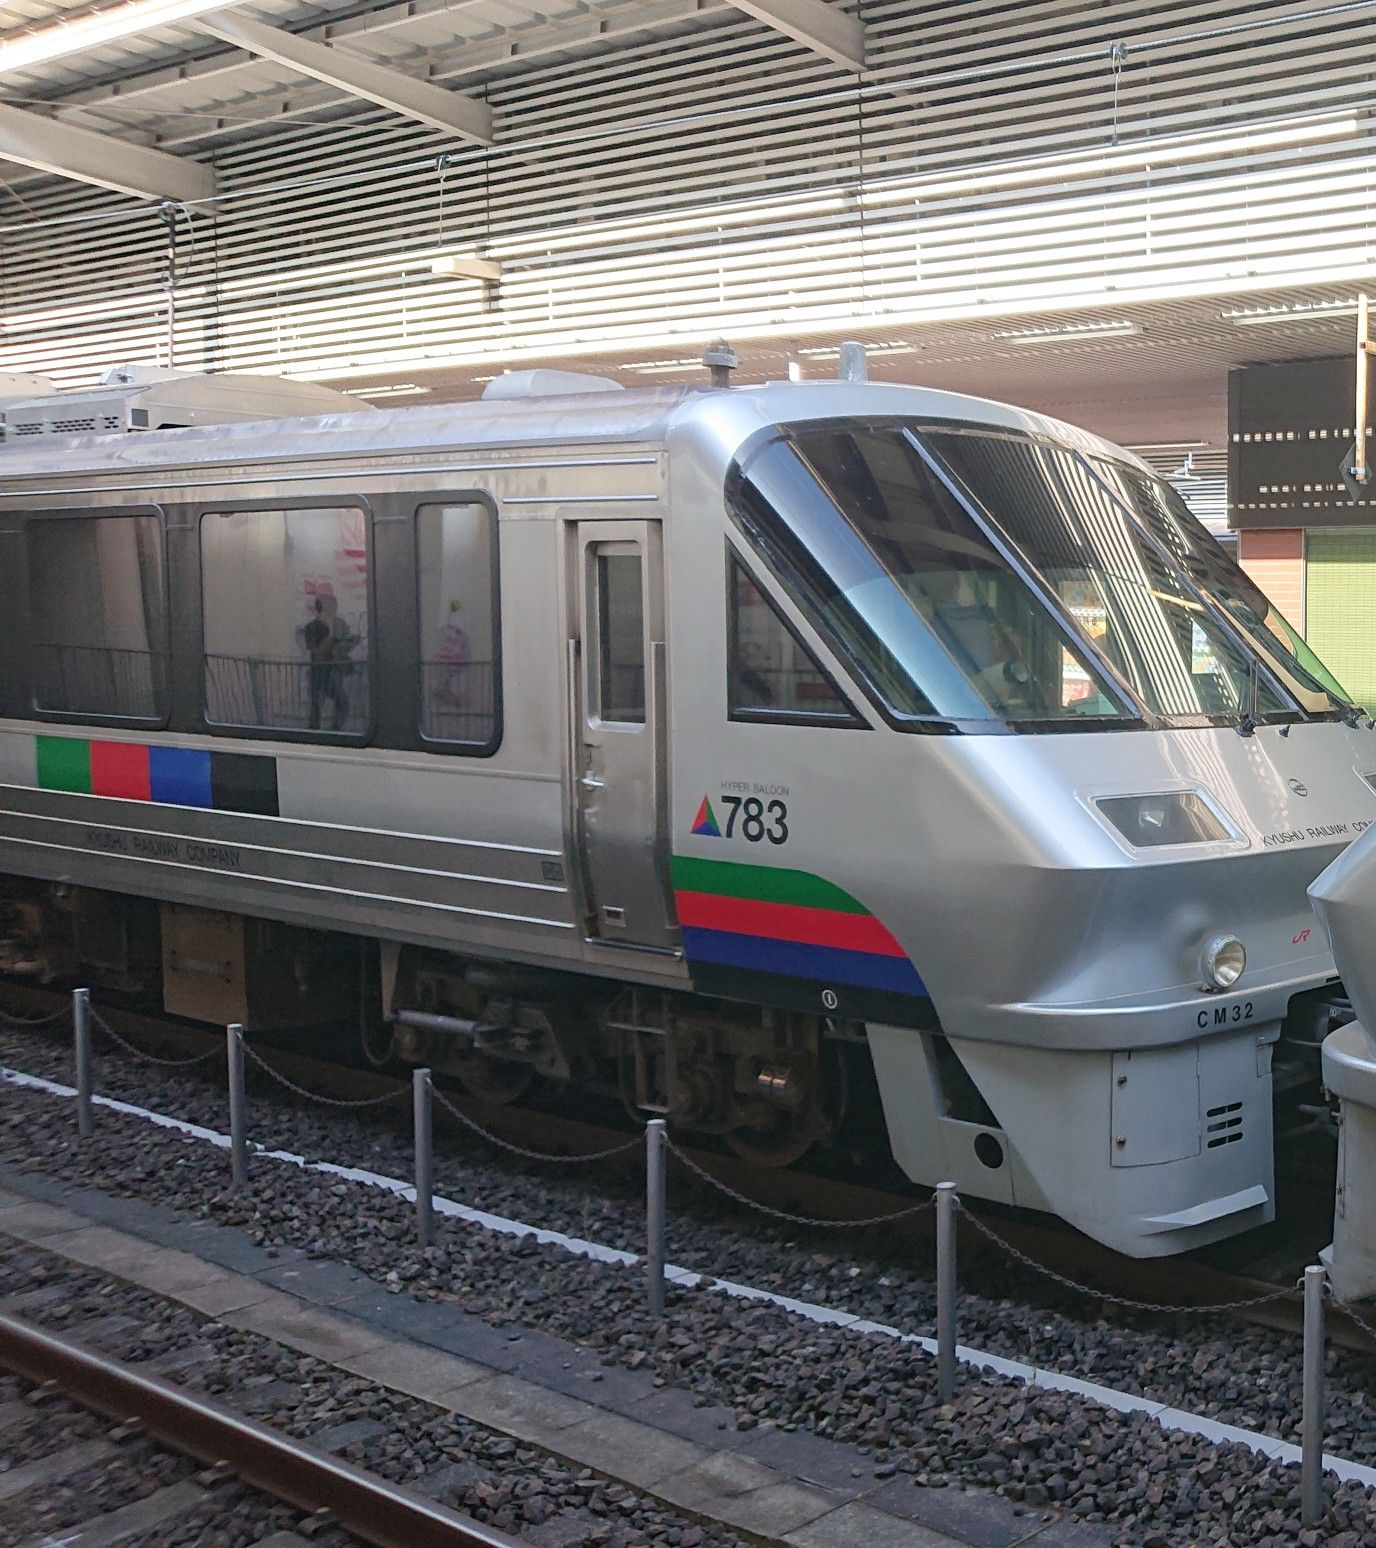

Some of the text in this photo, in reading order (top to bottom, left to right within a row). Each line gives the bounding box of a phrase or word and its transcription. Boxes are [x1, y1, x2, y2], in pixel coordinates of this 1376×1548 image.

[720, 781, 789, 796] HYPER SALOON
[721, 795, 789, 845] 783
[1261, 830, 1305, 847] KYUSHU
[1307, 824, 1349, 839] RAILWAY
